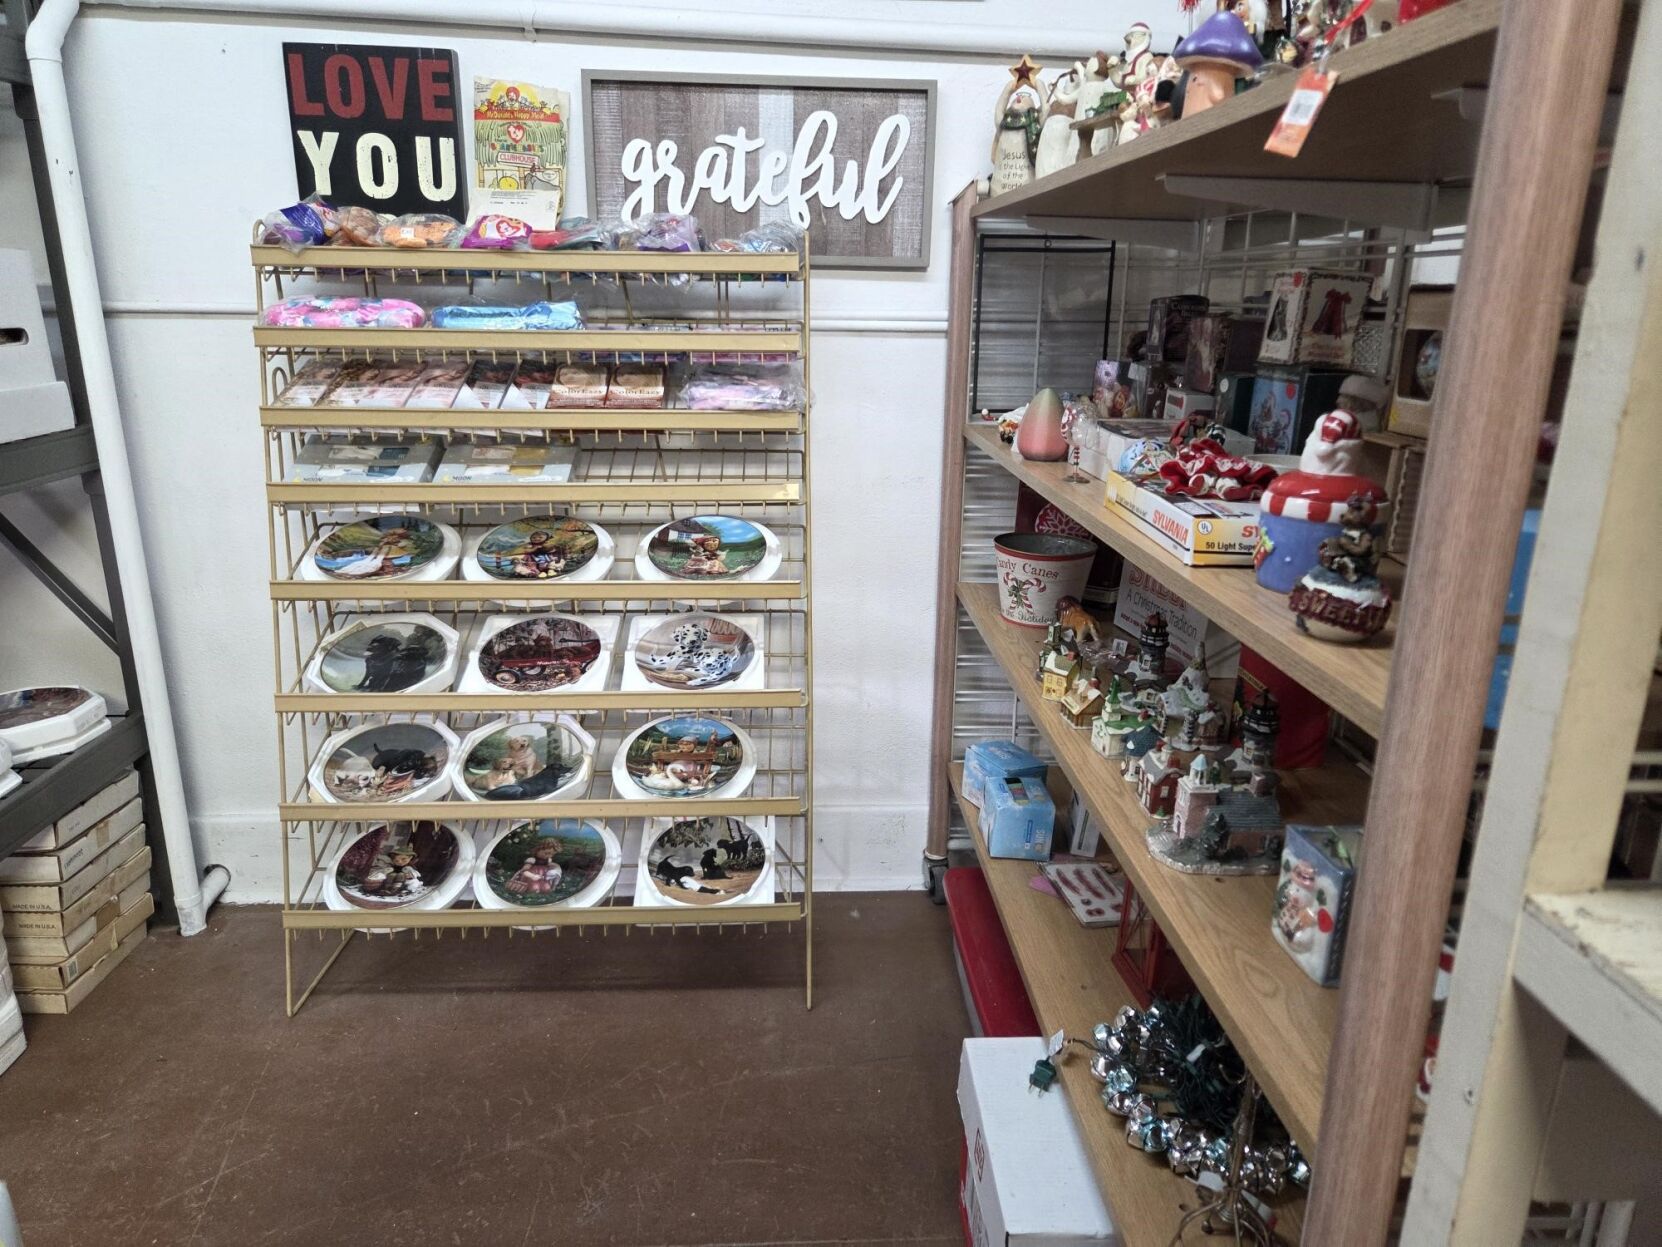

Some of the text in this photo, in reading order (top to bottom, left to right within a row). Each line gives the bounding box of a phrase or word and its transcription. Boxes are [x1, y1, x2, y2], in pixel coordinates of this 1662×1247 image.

[287, 53, 454, 121] LOVE
[297, 130, 457, 201] YOU
[499, 153, 537, 163] CLUBHOUSE
[1002, 148, 1026, 160] Jesus
[621, 110, 910, 230] grateful
[1152, 509, 1190, 545] SYLVANIA
[1205, 541, 1215, 550] 50
[1217, 541, 1237, 551] Light
[1022, 562, 1060, 580] Canes
[1168, 610, 1198, 640] Tradition
